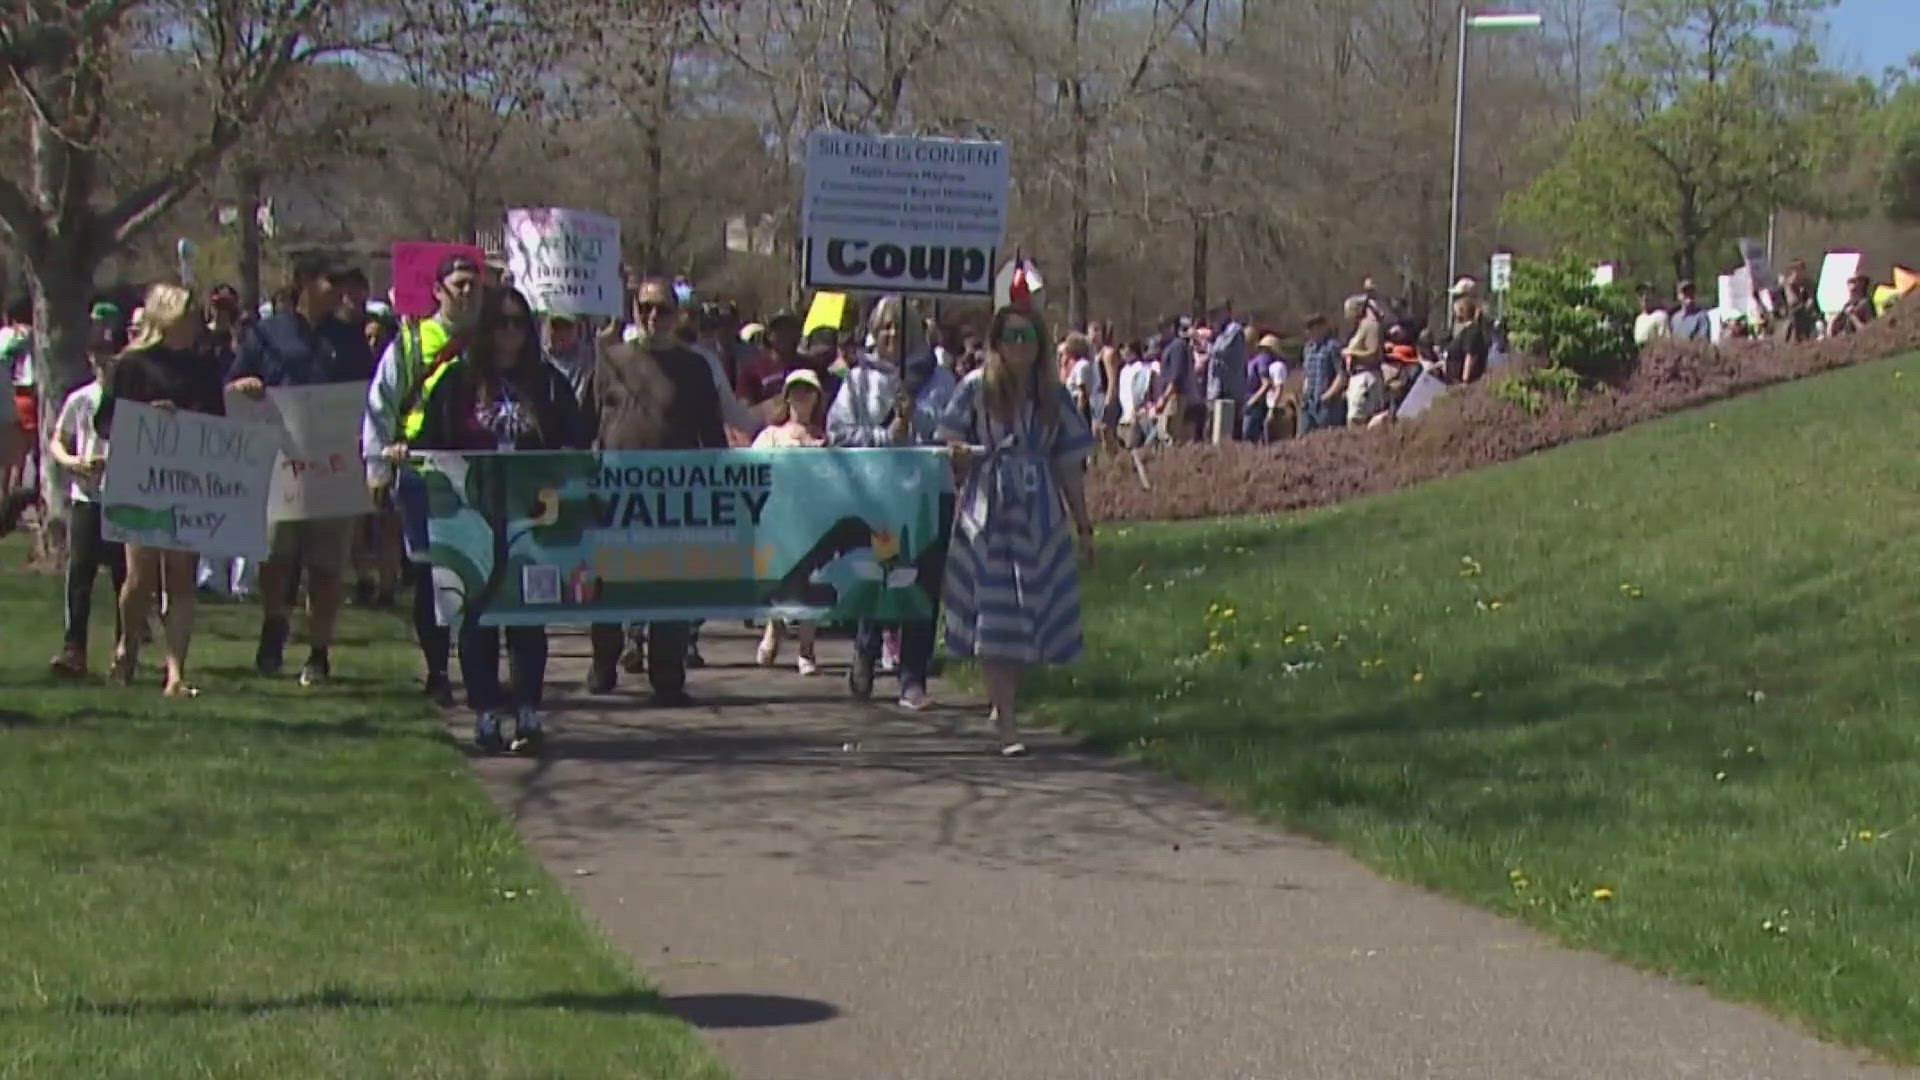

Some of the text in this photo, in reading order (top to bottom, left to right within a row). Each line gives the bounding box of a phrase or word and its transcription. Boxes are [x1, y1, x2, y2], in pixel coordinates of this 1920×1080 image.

[818, 138, 998, 166] SILENCE IS CONSENT
[827, 237, 986, 292] Coup
[136, 411, 180, 457] NO
[588, 491, 772, 529] VALLEY
